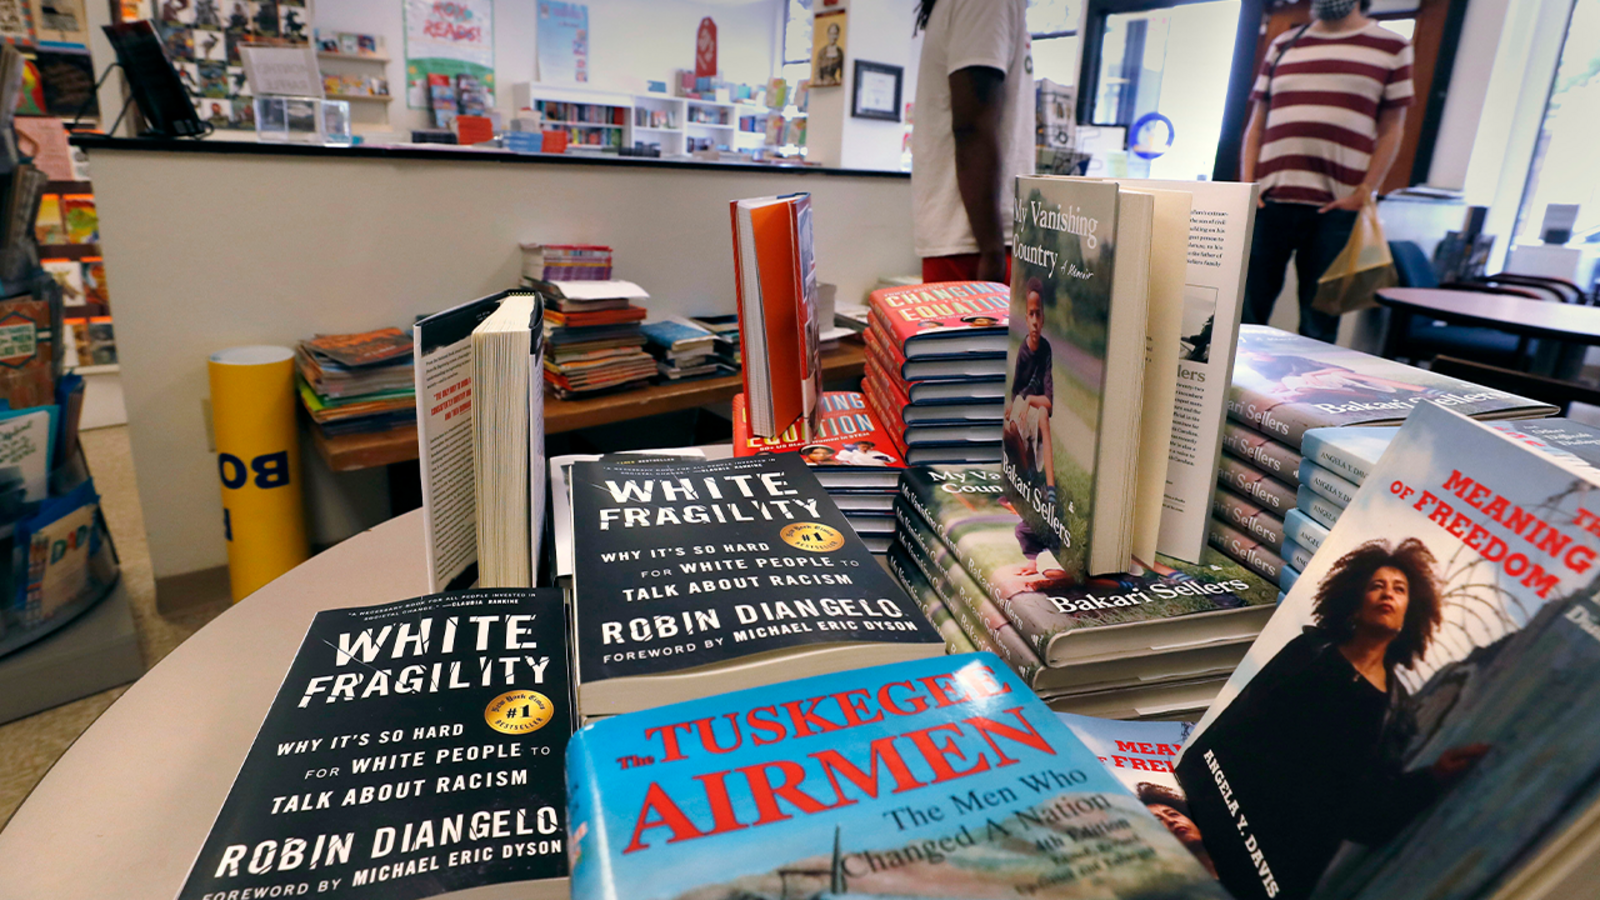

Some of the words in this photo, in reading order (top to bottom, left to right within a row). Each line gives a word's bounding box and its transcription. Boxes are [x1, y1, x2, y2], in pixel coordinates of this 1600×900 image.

[1014, 197, 1028, 233] My
[1031, 200, 1099, 250] Vanishing
[1012, 233, 1058, 279] Country
[1177, 364, 1206, 383] lers
[823, 392, 866, 412] ING
[1228, 399, 1245, 415] ari
[1245, 403, 1290, 436] Sellers
[1315, 398, 1415, 415] Bakari
[1418, 393, 1508, 409] ellers
[218, 450, 290, 490] BO
[1222, 433, 1238, 449] ari
[1240, 438, 1282, 472] Sellers
[1320, 451, 1347, 469] ANGELA
[605, 470, 799, 504] WHITE
[927, 470, 966, 483] My
[968, 470, 1001, 481] Va
[941, 483, 1004, 493] Coun
[1217, 467, 1234, 483] ari
[1237, 473, 1280, 508] Sellers
[1313, 476, 1338, 496] ANGELA
[599, 498, 822, 531] FRAGILITY
[1003, 451, 1031, 503] Bakari
[1032, 487, 1071, 549] Sellers
[1213, 499, 1231, 516] ari
[1233, 507, 1277, 544] Sellers
[1389, 480, 1415, 501] OF
[1412, 489, 1562, 600] FREEDOM
[1441, 468, 1597, 576] MEANING
[601, 549, 643, 564] WHY
[651, 545, 686, 557] IT'S
[693, 544, 716, 555] SO
[723, 541, 770, 553] HARD
[641, 567, 672, 579] FOR
[679, 558, 748, 574] WHITE
[755, 555, 834, 568] PEOPLE
[839, 559, 860, 568] TO
[1210, 531, 1229, 547] ari
[1231, 539, 1276, 577] Sellers
[622, 584, 680, 602] TALK
[688, 576, 760, 595] ABOUT
[770, 573, 853, 586] RACISM
[968, 557, 995, 598] Bakari
[994, 587, 1024, 631] Sellers
[1046, 587, 1153, 614] Bakari
[1149, 578, 1250, 600] Sellers
[359, 605, 403, 616] NECESSARY
[405, 600, 425, 608] BOOK
[363, 611, 399, 621] SOCIETAL
[601, 608, 721, 646] ROBIN
[734, 598, 904, 625] DIANGELO
[959, 586, 984, 623] Bakari
[984, 617, 1011, 661] Sellers
[335, 613, 537, 667] WHITE
[602, 644, 697, 664] FOREWORD
[704, 637, 725, 649] BY
[733, 622, 812, 643] MICHAEL
[817, 620, 857, 633] ERIC
[862, 619, 918, 633] DYSON
[297, 655, 550, 710] FRAGILITY
[491, 700, 506, 712] New
[506, 694, 526, 702] York
[528, 694, 546, 710] Times
[506, 704, 533, 719] #1
[644, 664, 1015, 764] TUSKEGEE
[277, 738, 323, 756] WHY
[329, 733, 370, 751] IT'S
[378, 730, 404, 743] SO
[412, 723, 465, 740] HARD
[495, 717, 543, 730] BESTSELLER
[304, 766, 340, 780] FOR
[351, 750, 426, 775] WHITE
[435, 742, 522, 765] PEOPLE
[531, 745, 551, 756] TO
[616, 754, 655, 771] The
[270, 793, 331, 815] TALK
[342, 780, 426, 808] ABOUT
[436, 769, 528, 794] RACISM
[622, 705, 1058, 857] AIRMEN
[883, 802, 946, 832] The
[949, 785, 1017, 817] Men
[1018, 768, 1088, 797] Who
[214, 832, 356, 879] ROBIN
[370, 805, 560, 860] DIANGELO
[841, 827, 976, 880] Changed
[985, 818, 1010, 843] A
[1013, 792, 1112, 833] Nation
[1203, 749, 1240, 817] ANGELA
[1236, 813, 1249, 837] Y.
[1244, 833, 1280, 899] DAVIS
[201, 881, 309, 900] FOREWORD
[316, 878, 344, 893] BY
[351, 857, 440, 886] MICHAEL
[447, 847, 494, 867] ERIC
[501, 838, 563, 859] DYSON
